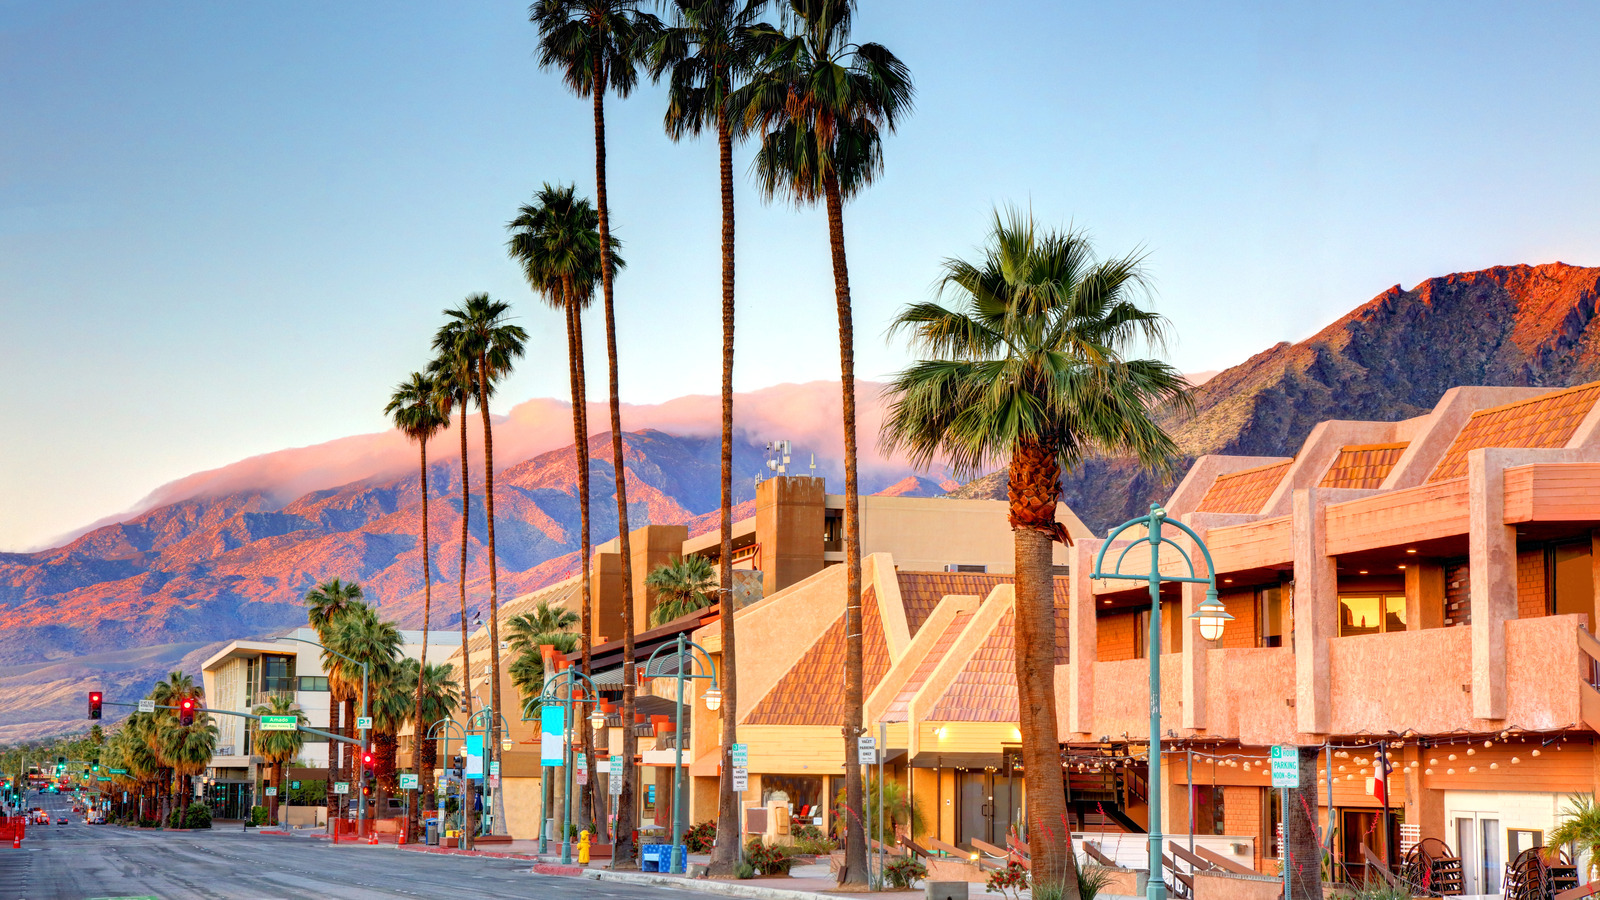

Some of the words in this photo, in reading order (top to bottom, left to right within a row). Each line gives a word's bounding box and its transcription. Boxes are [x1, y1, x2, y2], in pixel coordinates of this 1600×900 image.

[358, 718, 366, 727] P
[1274, 748, 1280, 756] 3
[402, 778, 409, 787] P
